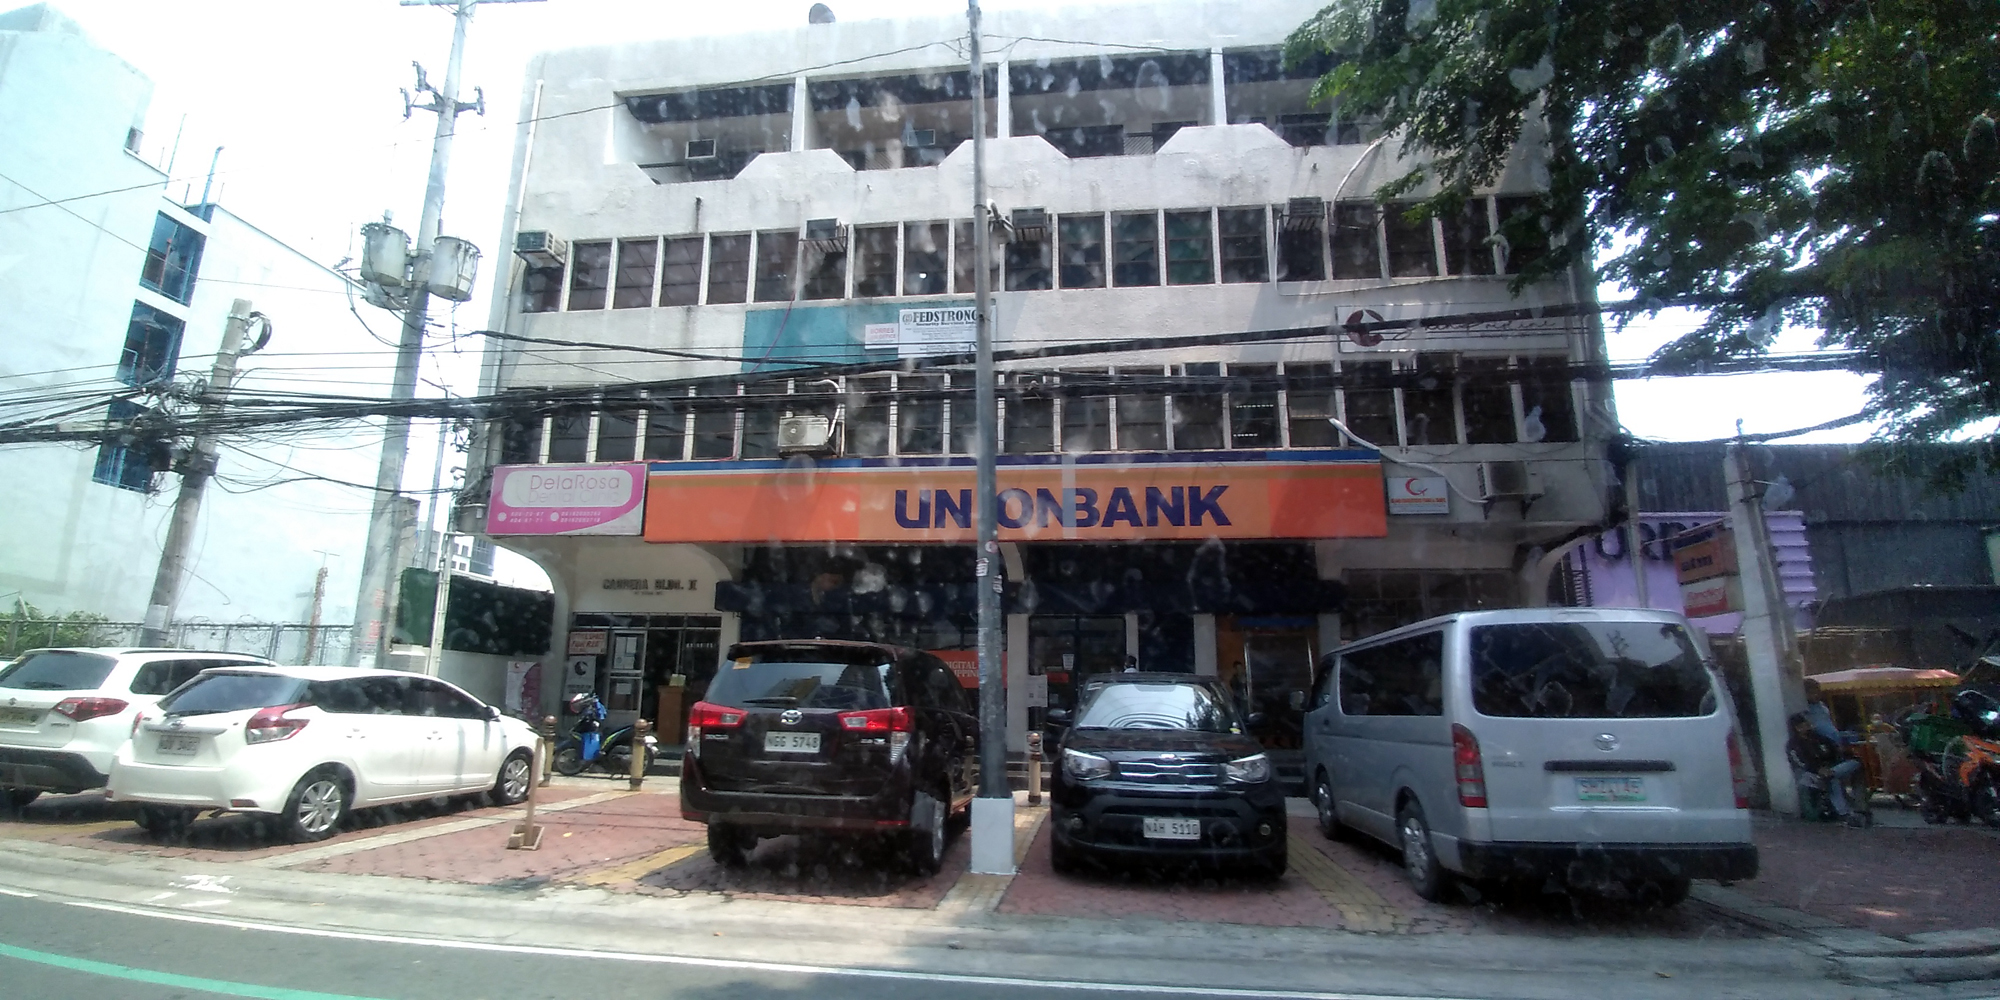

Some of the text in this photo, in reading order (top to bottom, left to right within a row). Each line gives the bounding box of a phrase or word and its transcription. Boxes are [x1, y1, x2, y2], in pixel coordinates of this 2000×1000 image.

[530, 474, 621, 490] DelaRosa
[893, 484, 1233, 530] UNONBANK
[792, 736, 820, 749] 5748
[1172, 822, 1199, 835] 5110
